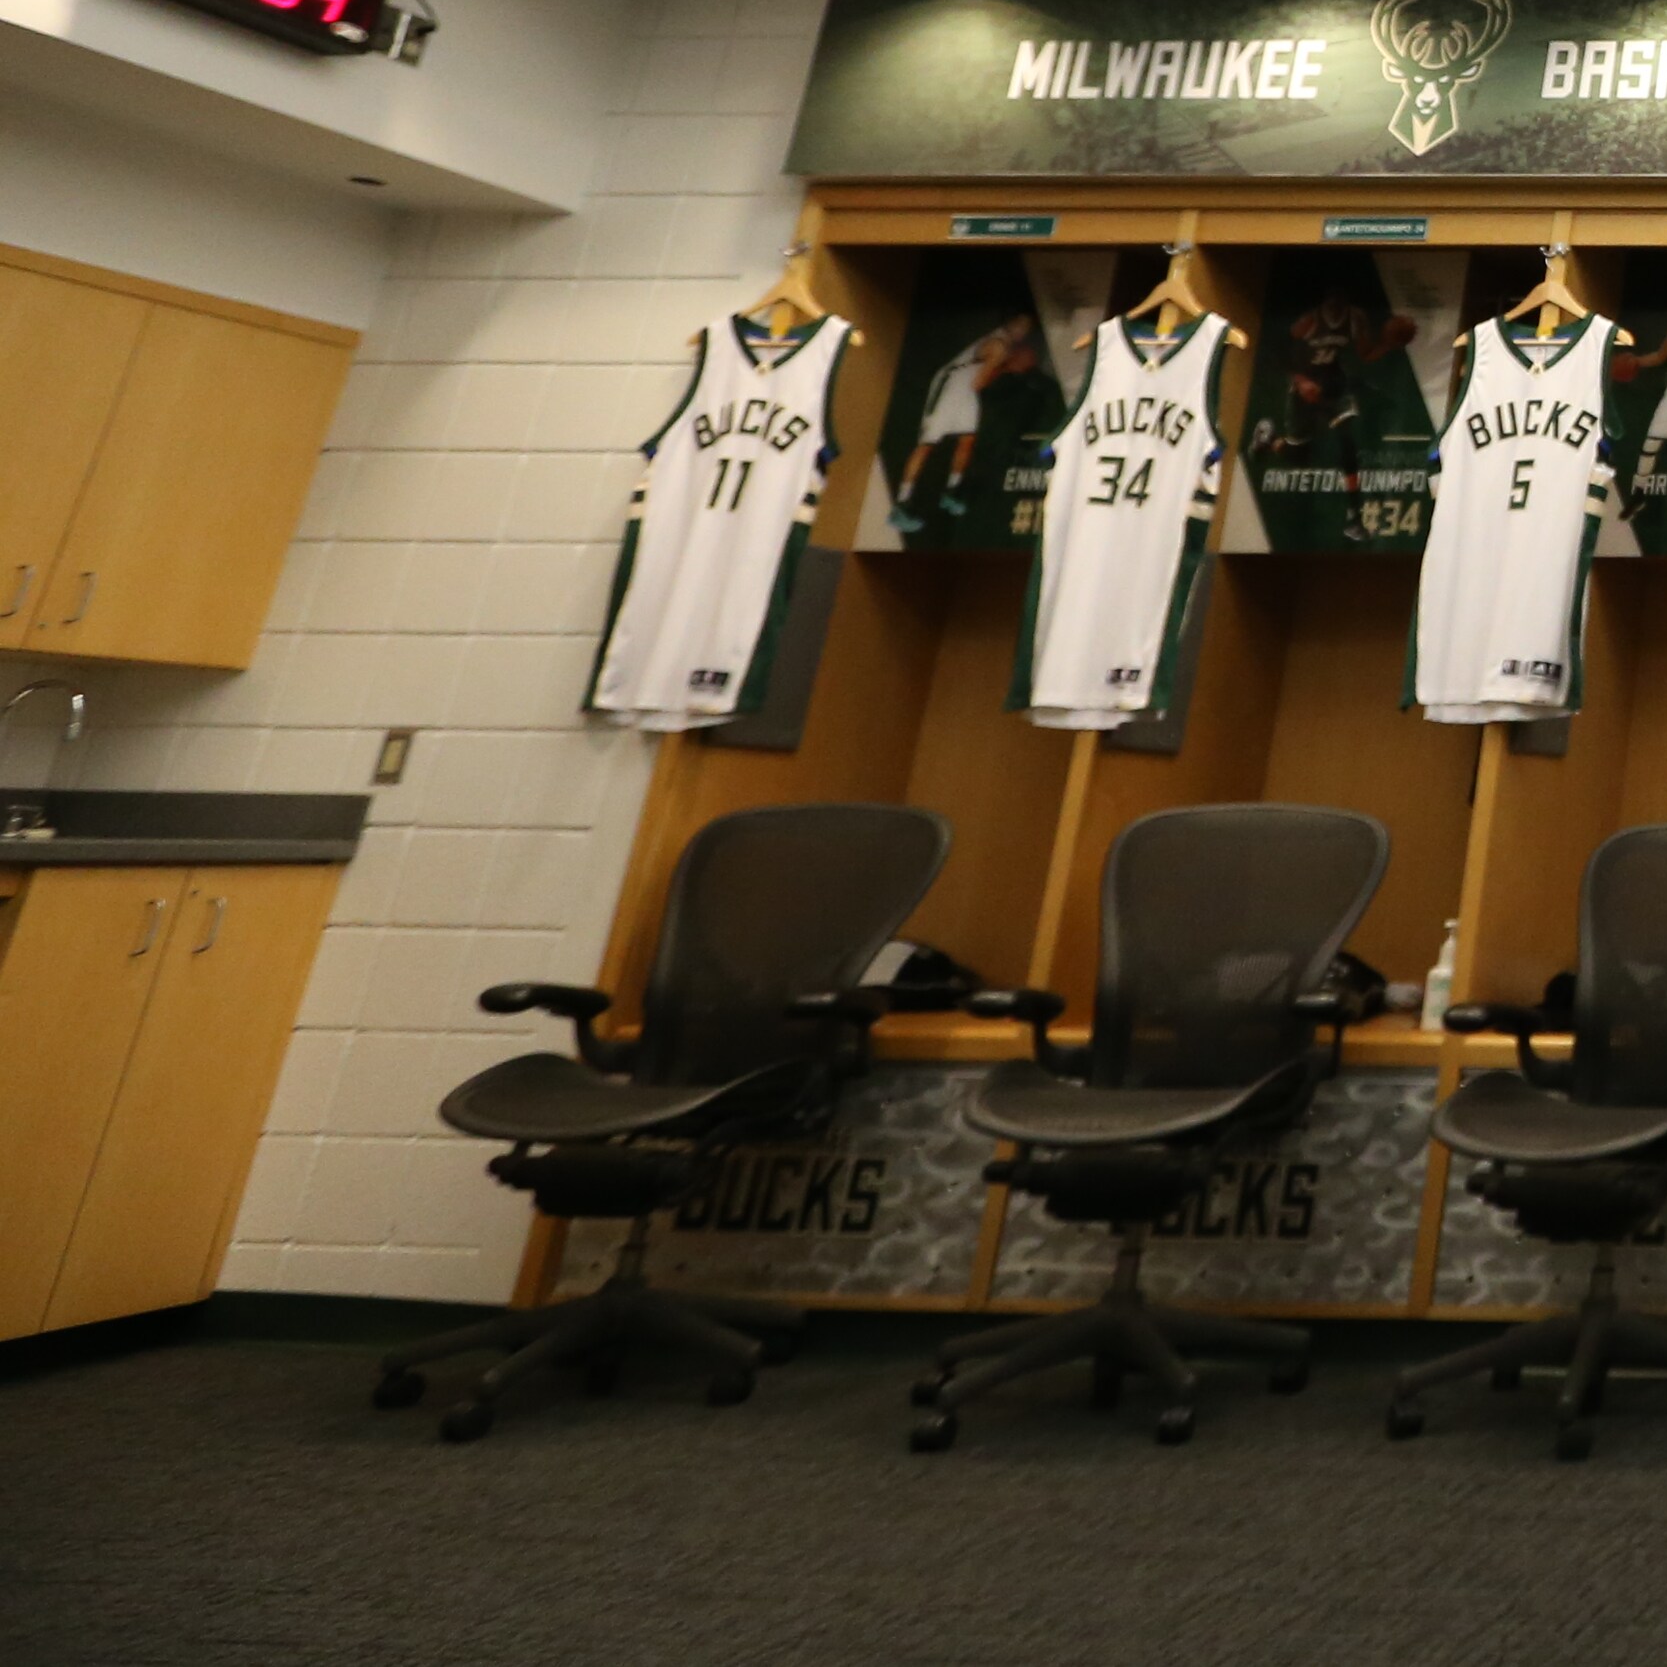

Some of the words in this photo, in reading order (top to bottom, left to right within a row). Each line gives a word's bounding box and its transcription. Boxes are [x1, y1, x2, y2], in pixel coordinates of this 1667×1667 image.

[1007, 39, 1327, 100] MILWAUKEE
[692, 398, 809, 453] BUCKS
[1084, 396, 1196, 449] BUCKS
[1465, 398, 1598, 452] BUCKS
[706, 457, 754, 512] 11
[1003, 466, 1047, 492] ENN
[1087, 456, 1157, 509] 34
[1262, 467, 1428, 494] ANTETOKUNMPO
[1507, 459, 1536, 511] 5
[1360, 497, 1423, 538] #34
[1168, 1160, 1320, 1237] CKS
